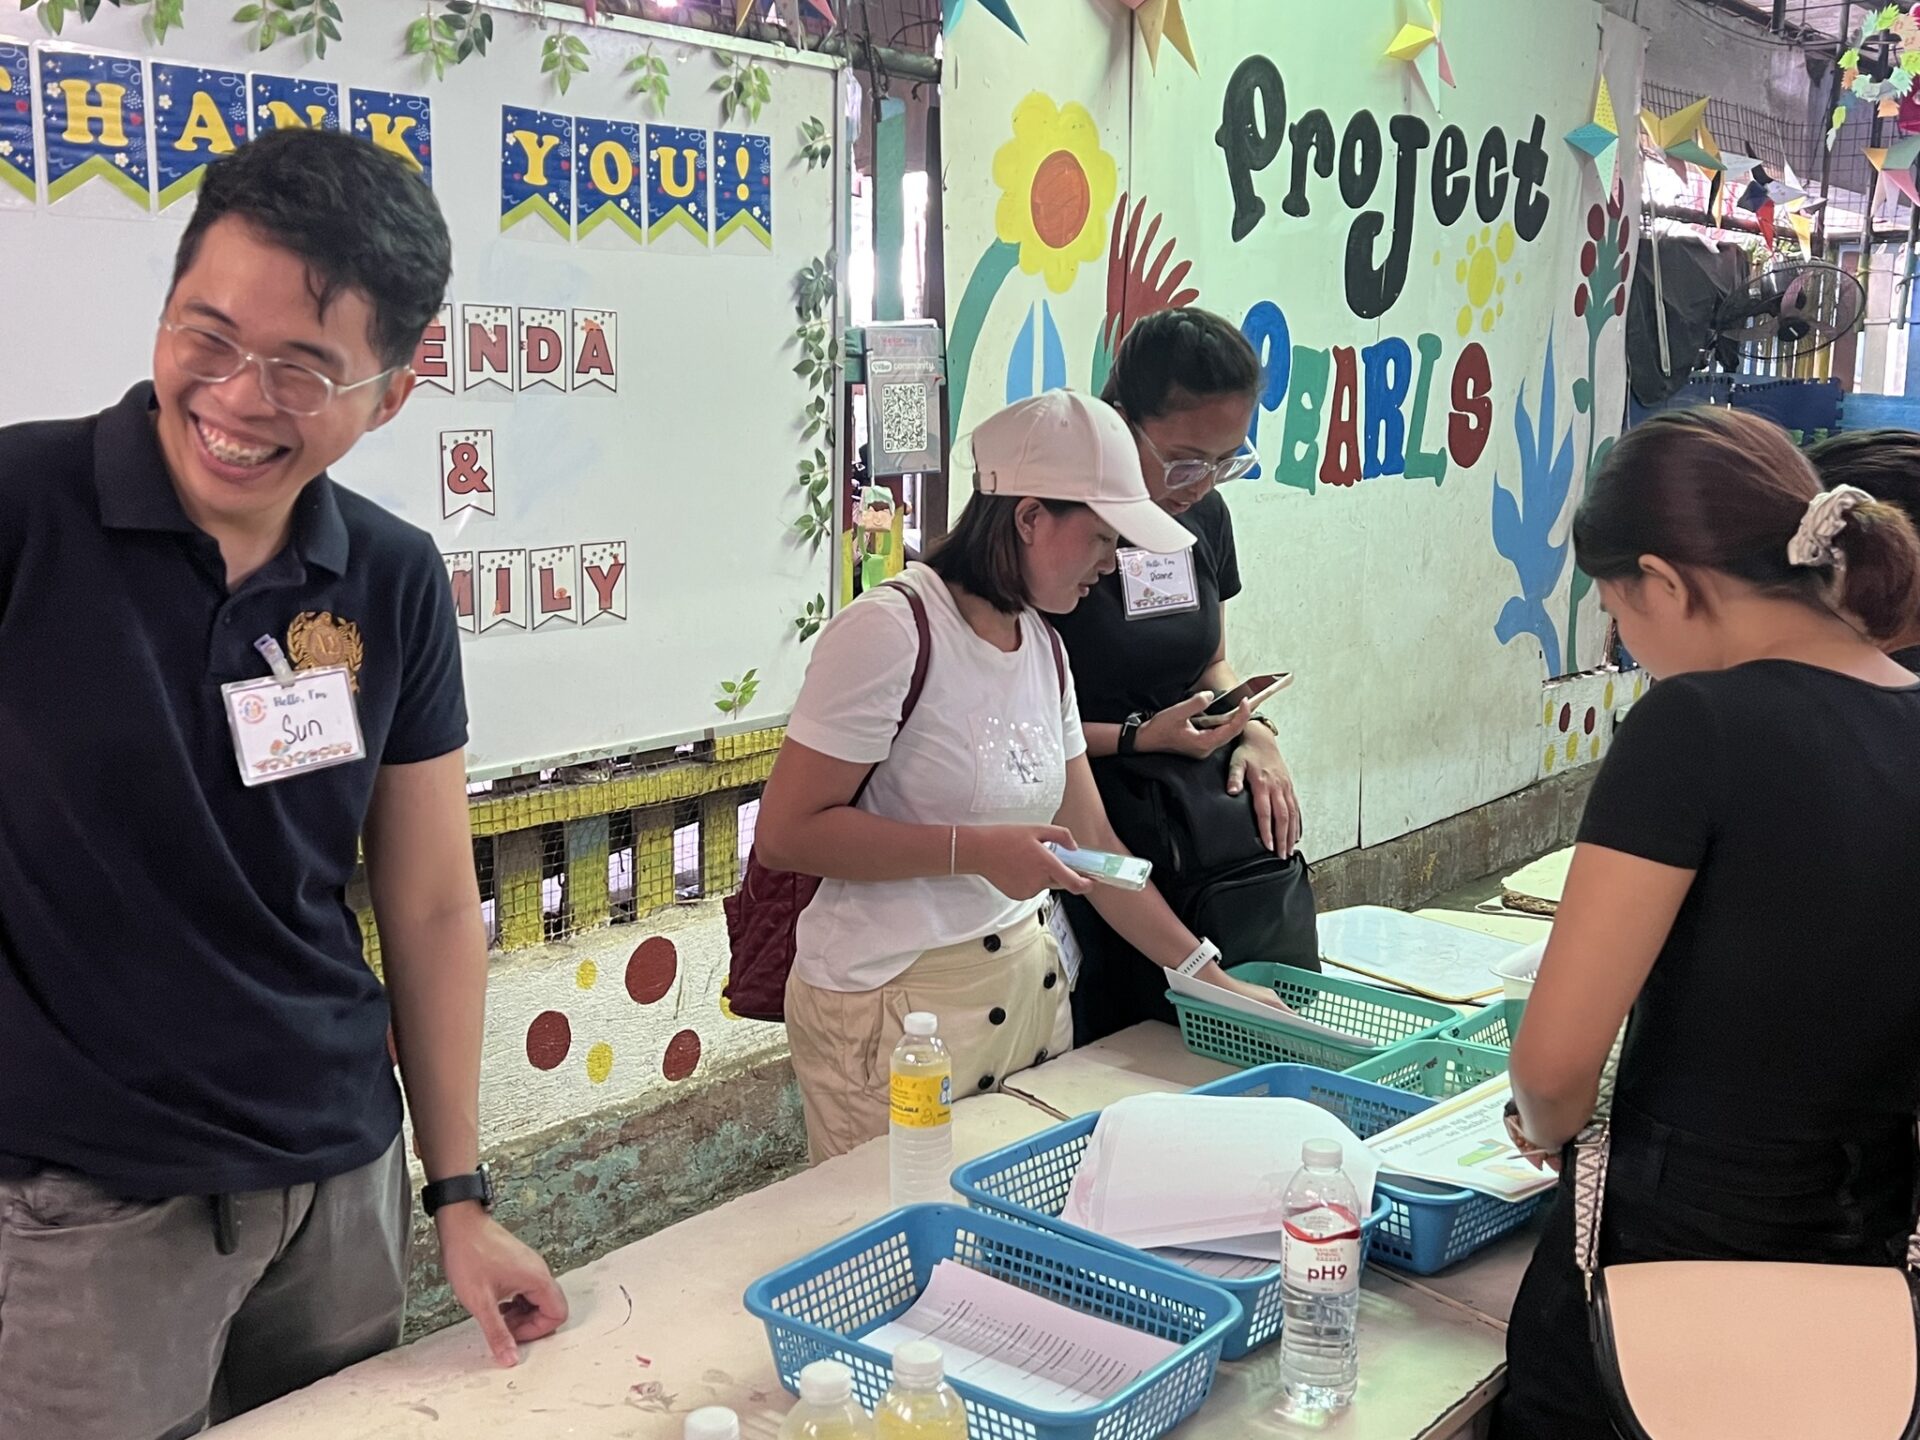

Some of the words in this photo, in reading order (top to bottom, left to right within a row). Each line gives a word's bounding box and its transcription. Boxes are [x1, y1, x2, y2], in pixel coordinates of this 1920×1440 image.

[513, 130, 749, 201] YOU!
[1239, 300, 1492, 495] PEARLS
[447, 442, 492, 495] &
[282, 714, 322, 745] Sun
[1308, 1264, 1347, 1282] pH9
